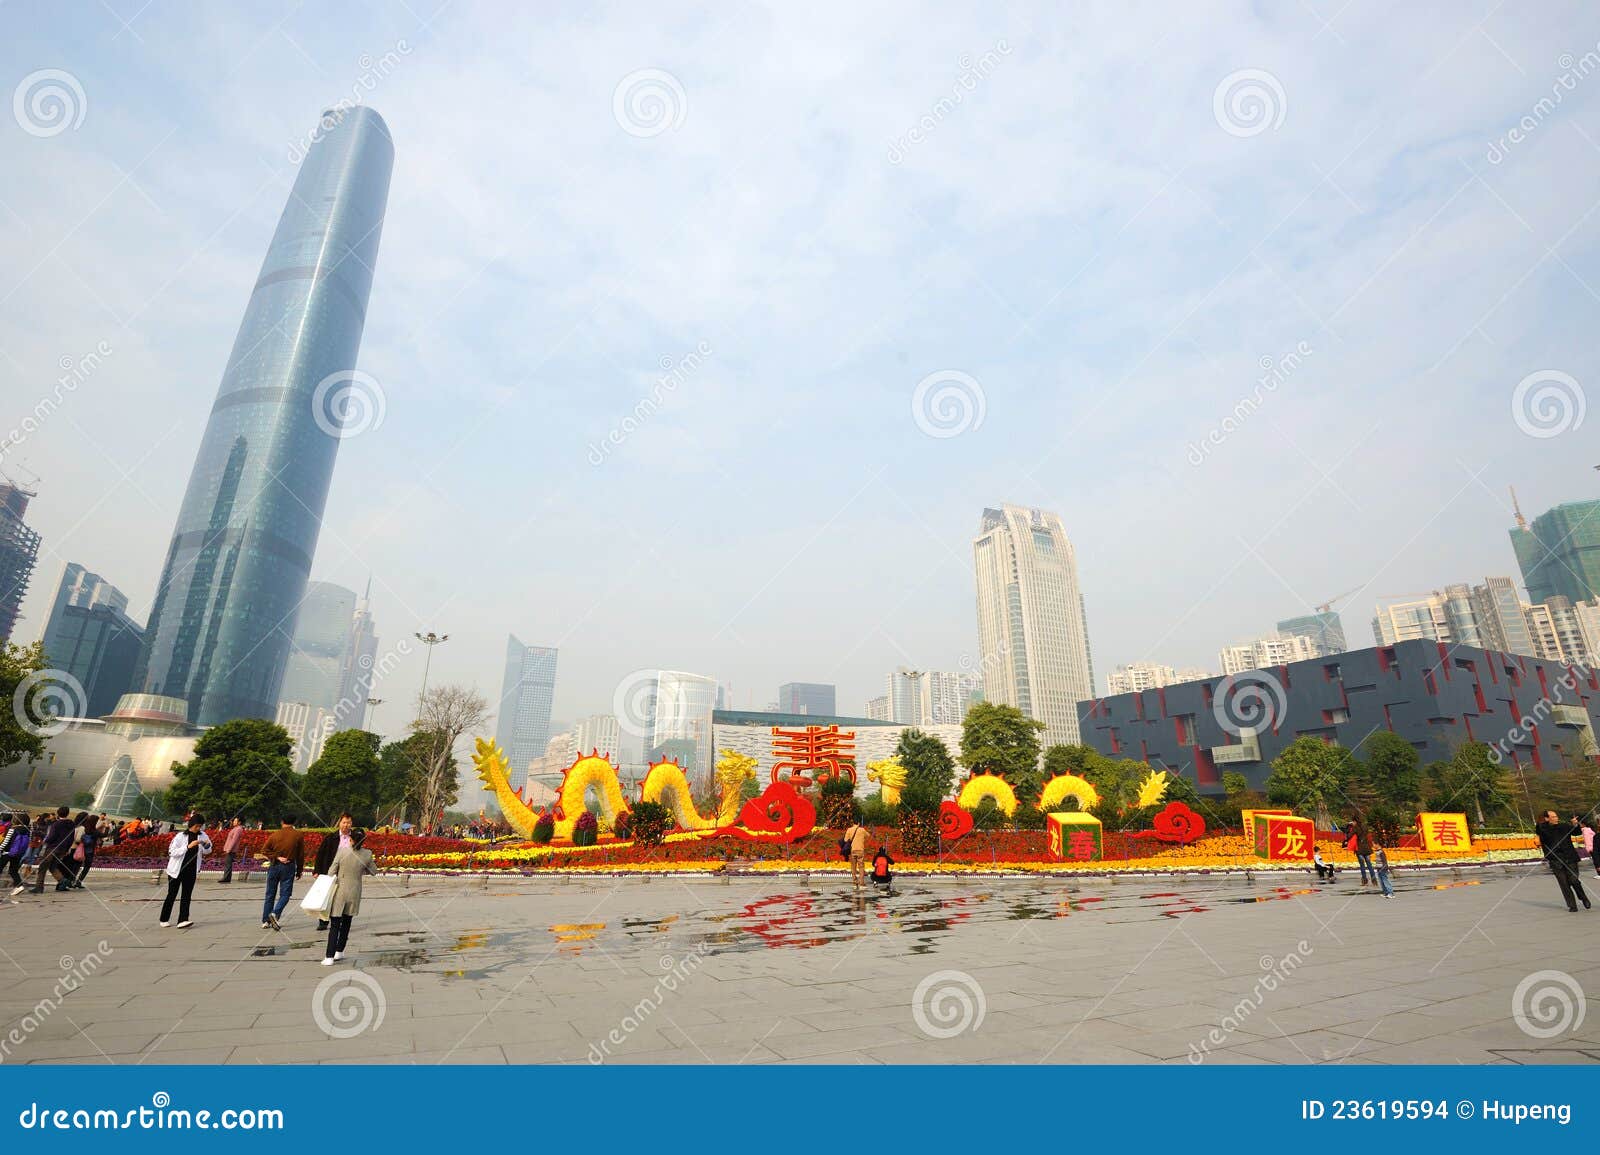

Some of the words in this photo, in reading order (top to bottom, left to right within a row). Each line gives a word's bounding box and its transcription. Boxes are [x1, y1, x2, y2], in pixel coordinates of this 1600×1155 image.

[1068, 830, 1097, 859] 春
[1277, 826, 1308, 857] 龙
[1431, 820, 1463, 846] 春
